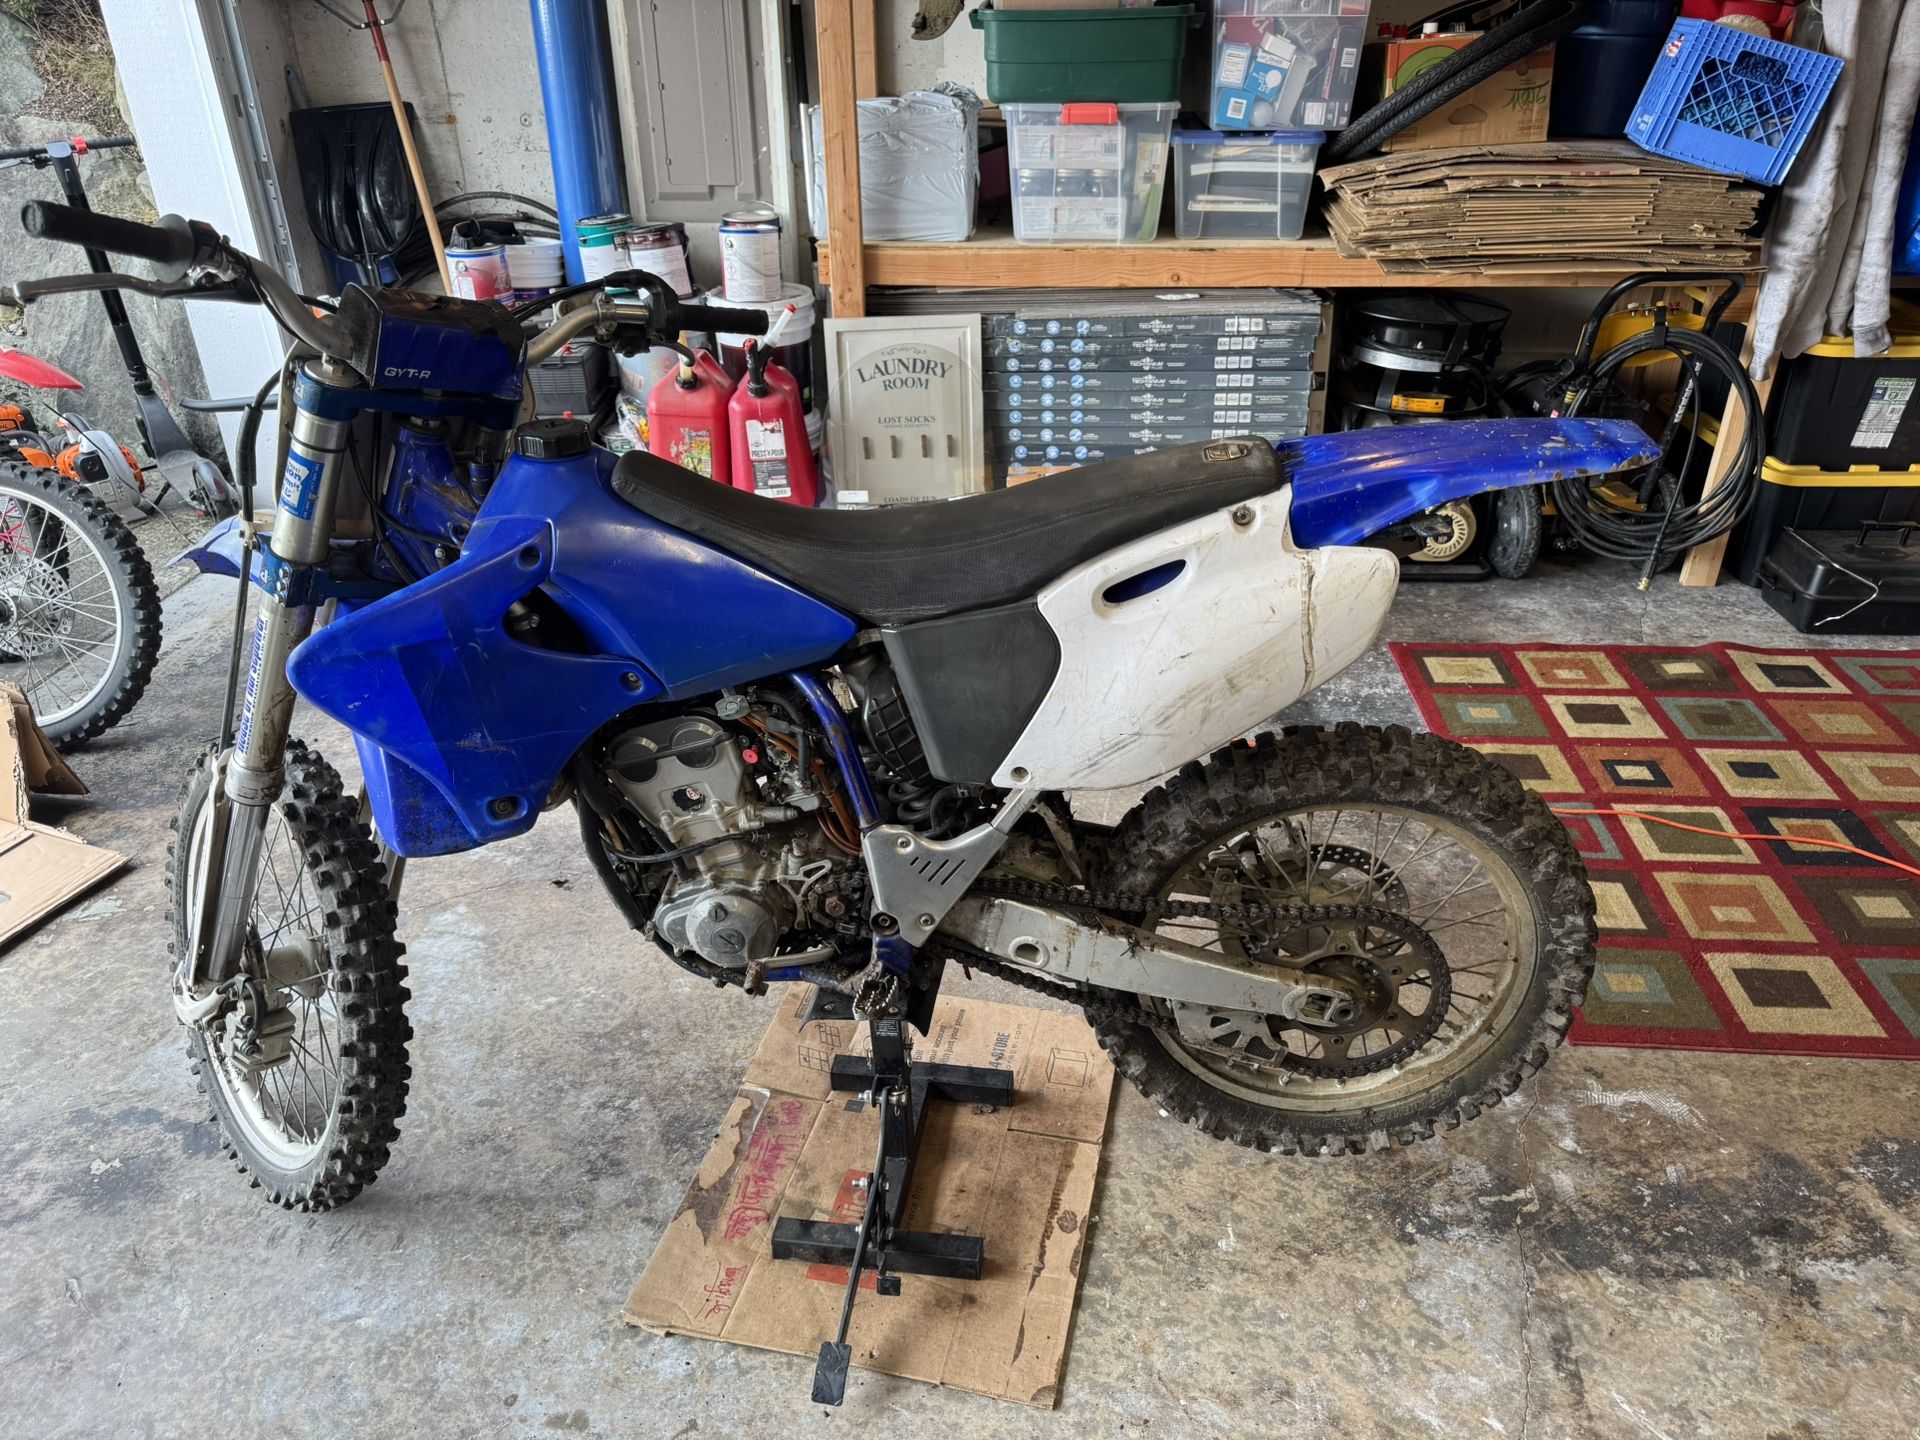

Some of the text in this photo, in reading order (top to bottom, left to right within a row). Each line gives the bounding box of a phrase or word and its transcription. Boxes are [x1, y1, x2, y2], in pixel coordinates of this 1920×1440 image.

[856, 357, 954, 384] LAUNDRY
[882, 376, 930, 392] ROOM
[878, 415, 936, 425] LOST SOCKS
[934, 1024, 947, 1049] account
[951, 1025, 960, 1041] your
[956, 1008, 966, 1027] phone
